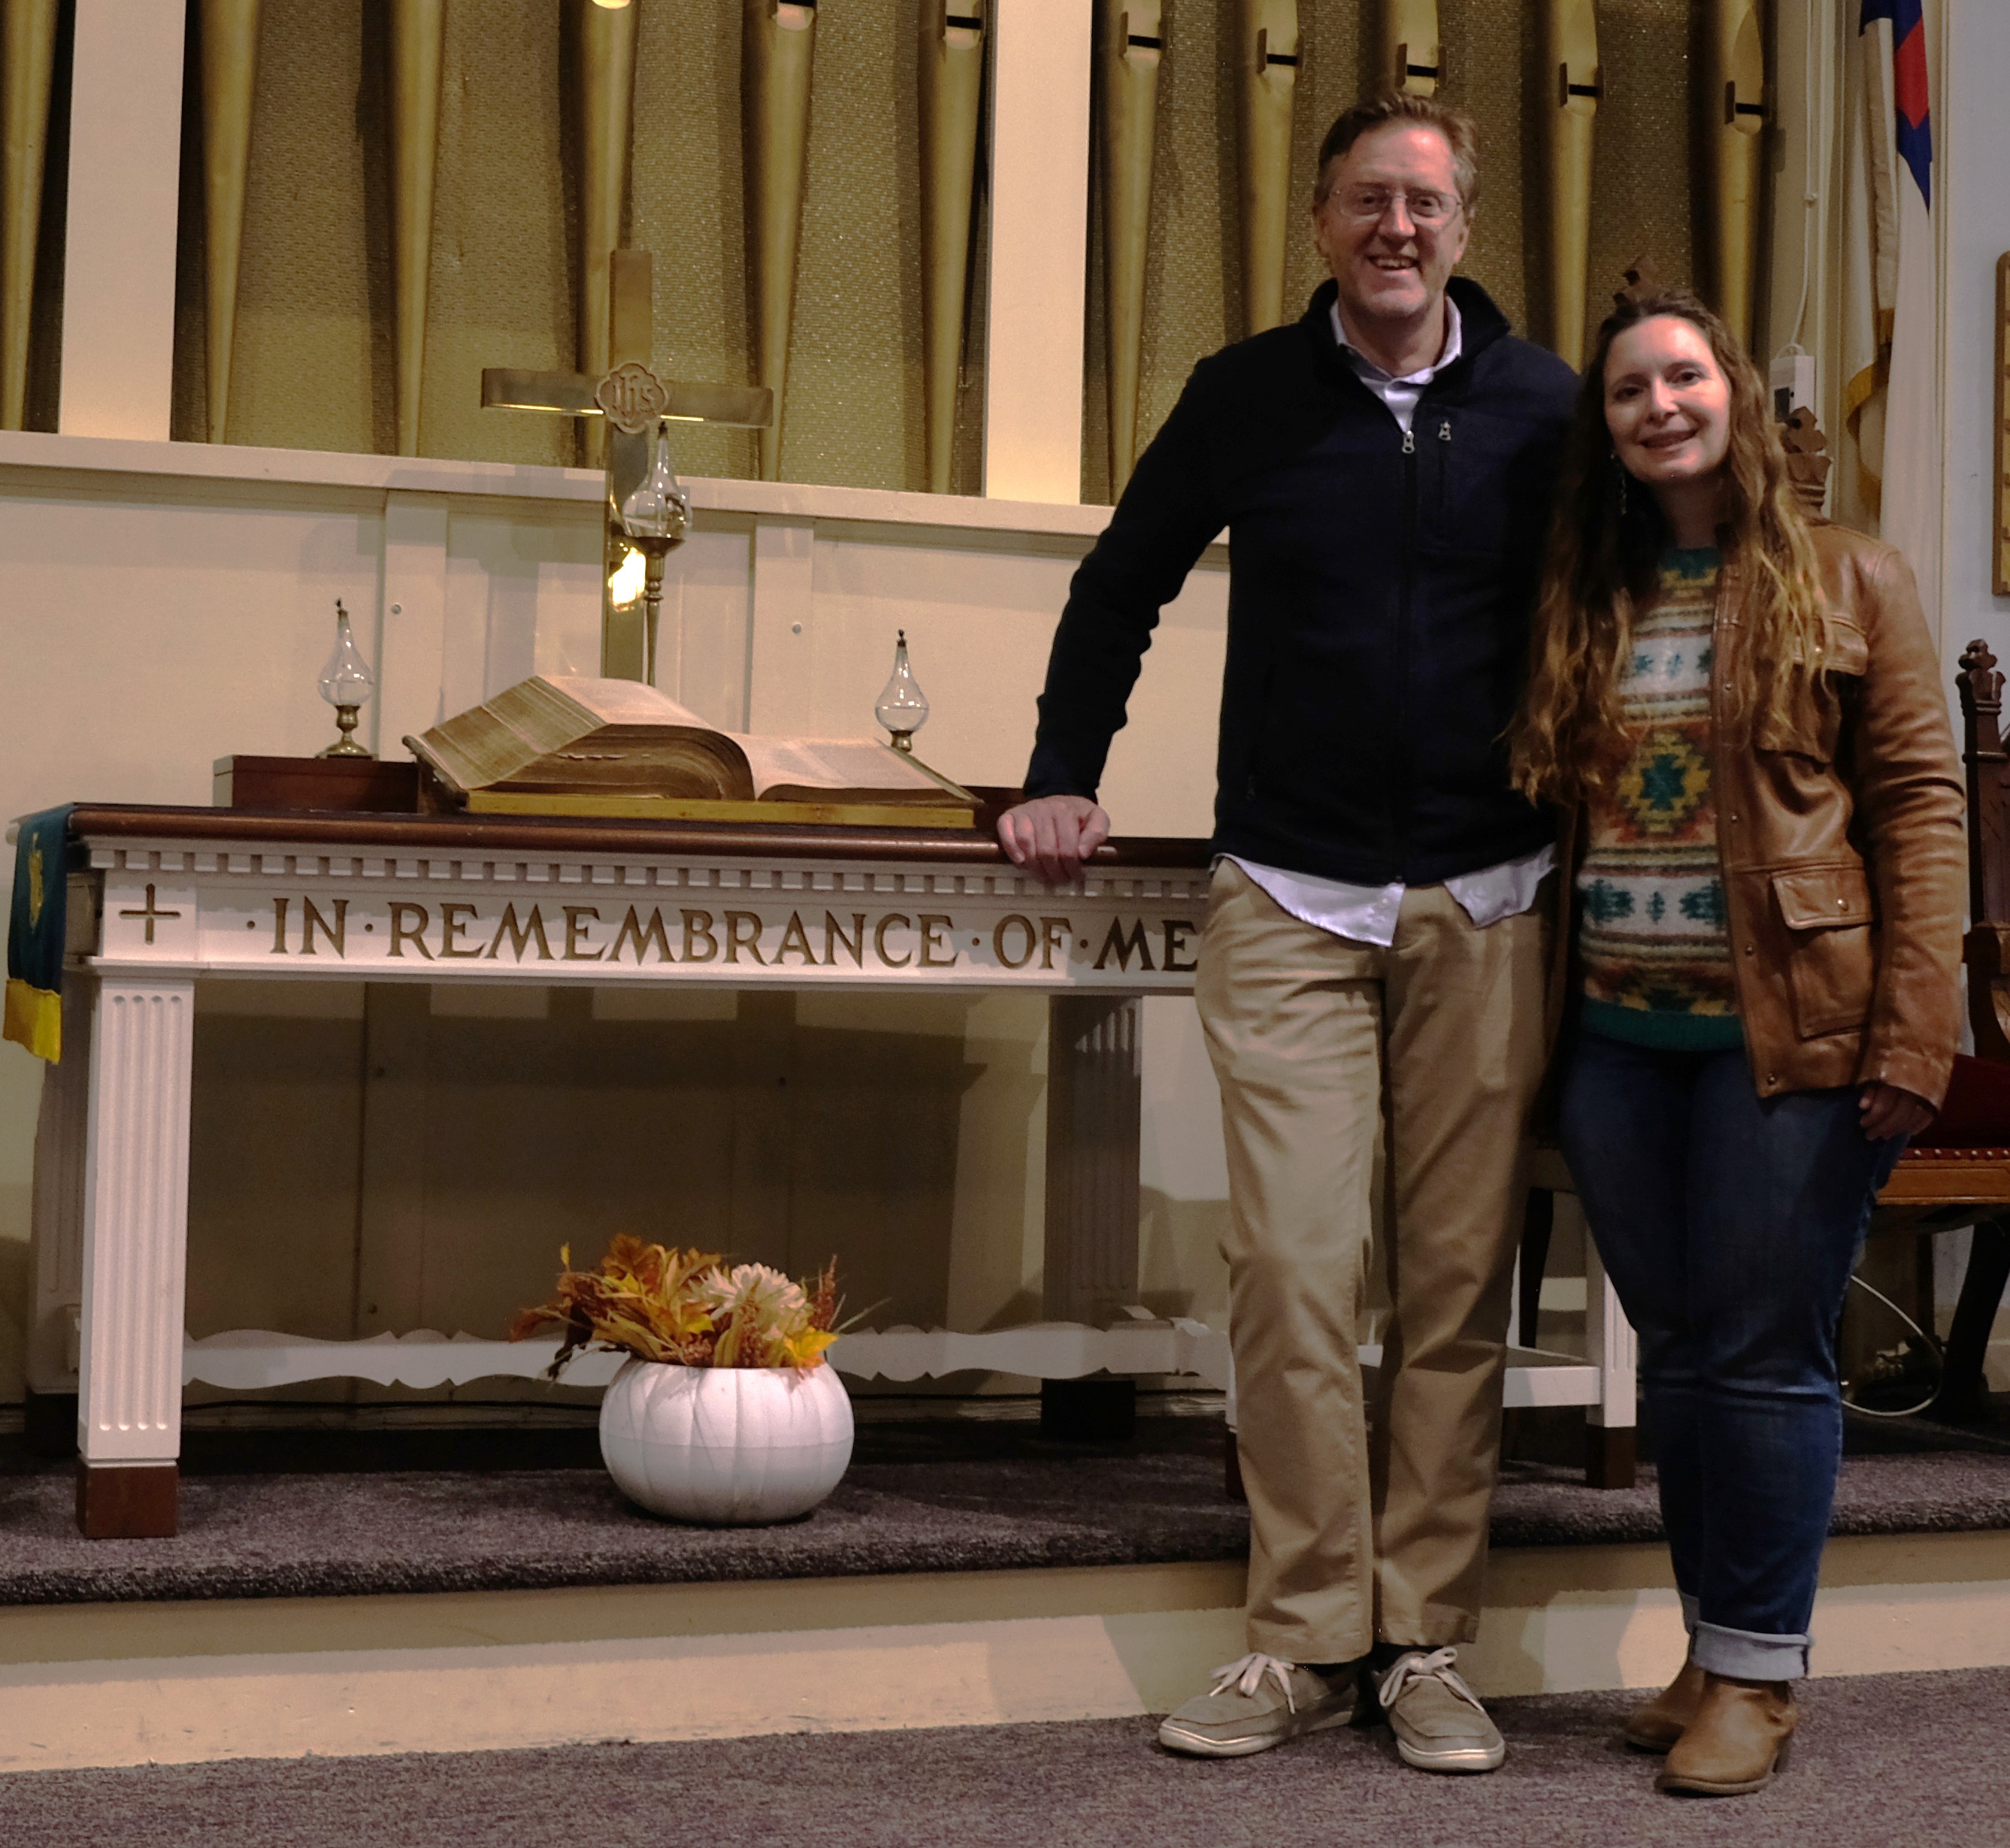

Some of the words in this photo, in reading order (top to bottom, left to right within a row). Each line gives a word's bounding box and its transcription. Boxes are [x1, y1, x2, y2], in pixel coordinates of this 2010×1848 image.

[269, 896, 350, 958] IN
[386, 901, 960, 969] REMEMBRANCE
[991, 913, 1073, 971] OF
[1092, 915, 1198, 973] ME
